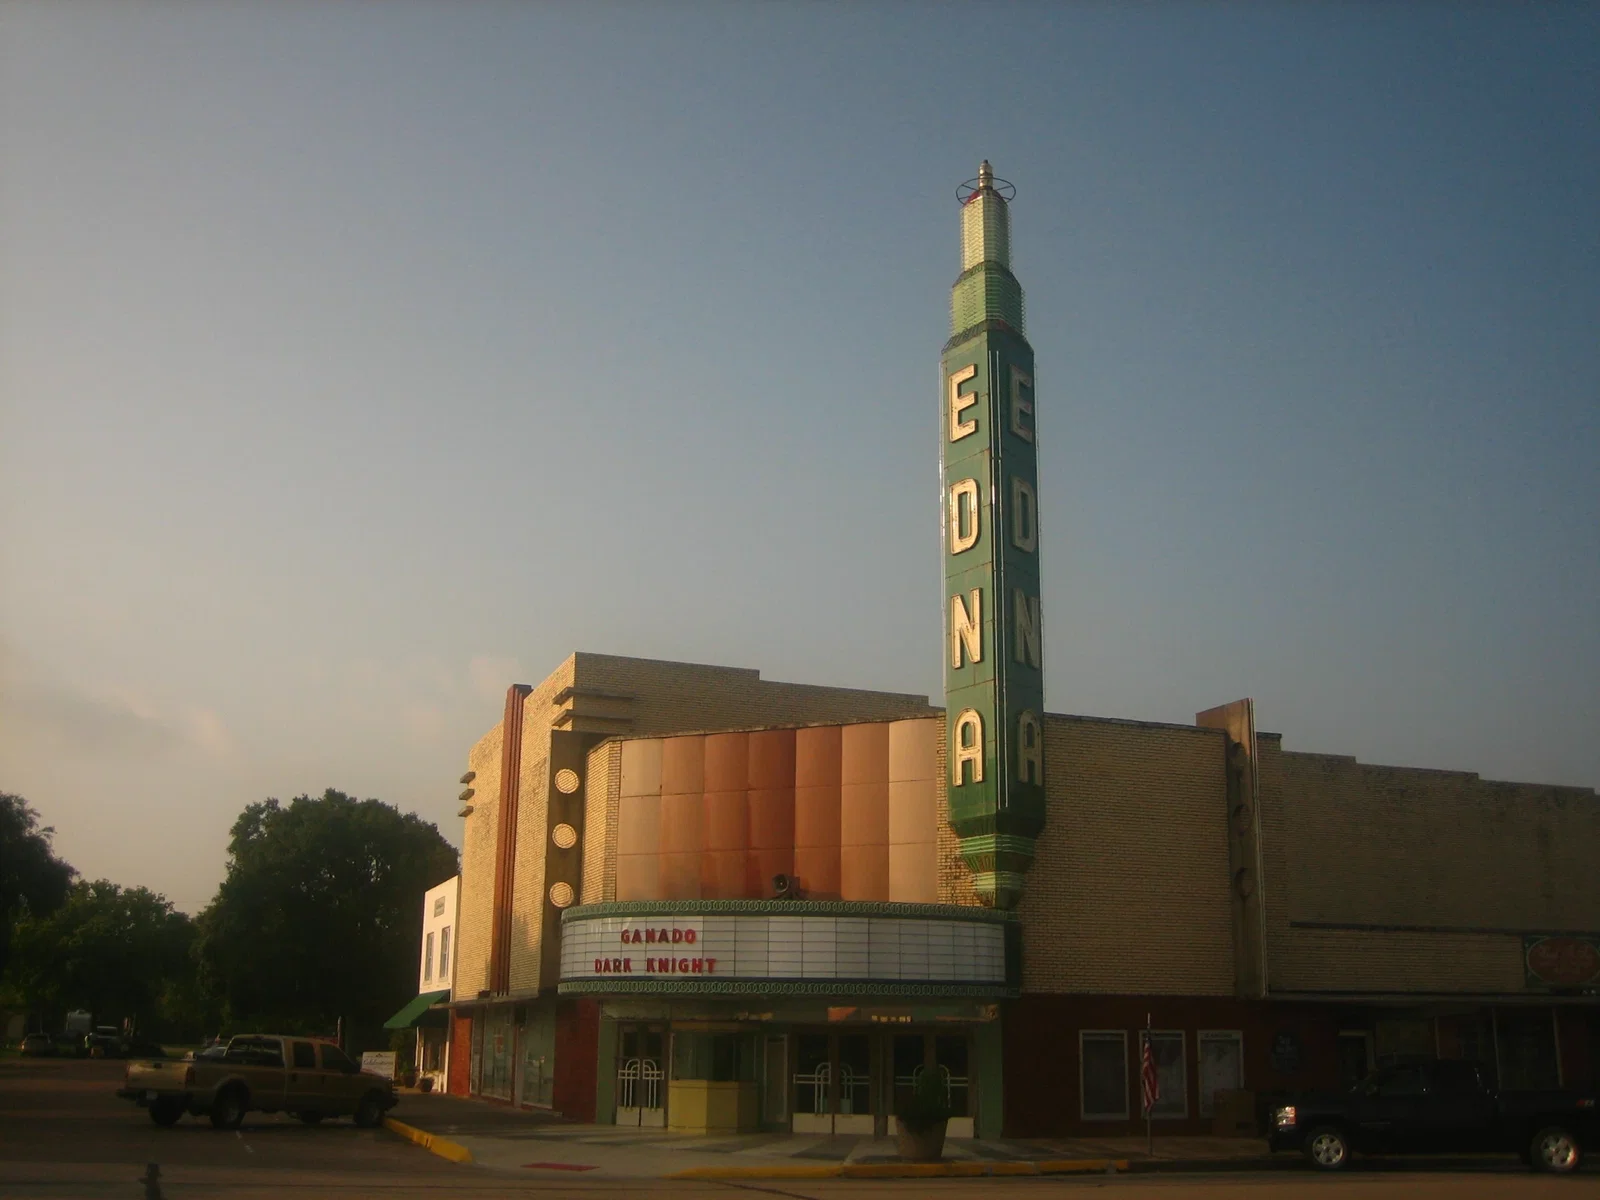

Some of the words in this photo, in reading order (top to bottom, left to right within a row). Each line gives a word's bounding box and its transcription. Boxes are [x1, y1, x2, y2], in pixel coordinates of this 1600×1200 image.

[948, 363, 984, 786] EDNA
[1009, 364, 1043, 787] EDNA
[594, 957, 632, 973] DARK
[646, 957, 717, 974] KNIGHT
[621, 928, 696, 944] GANADO
